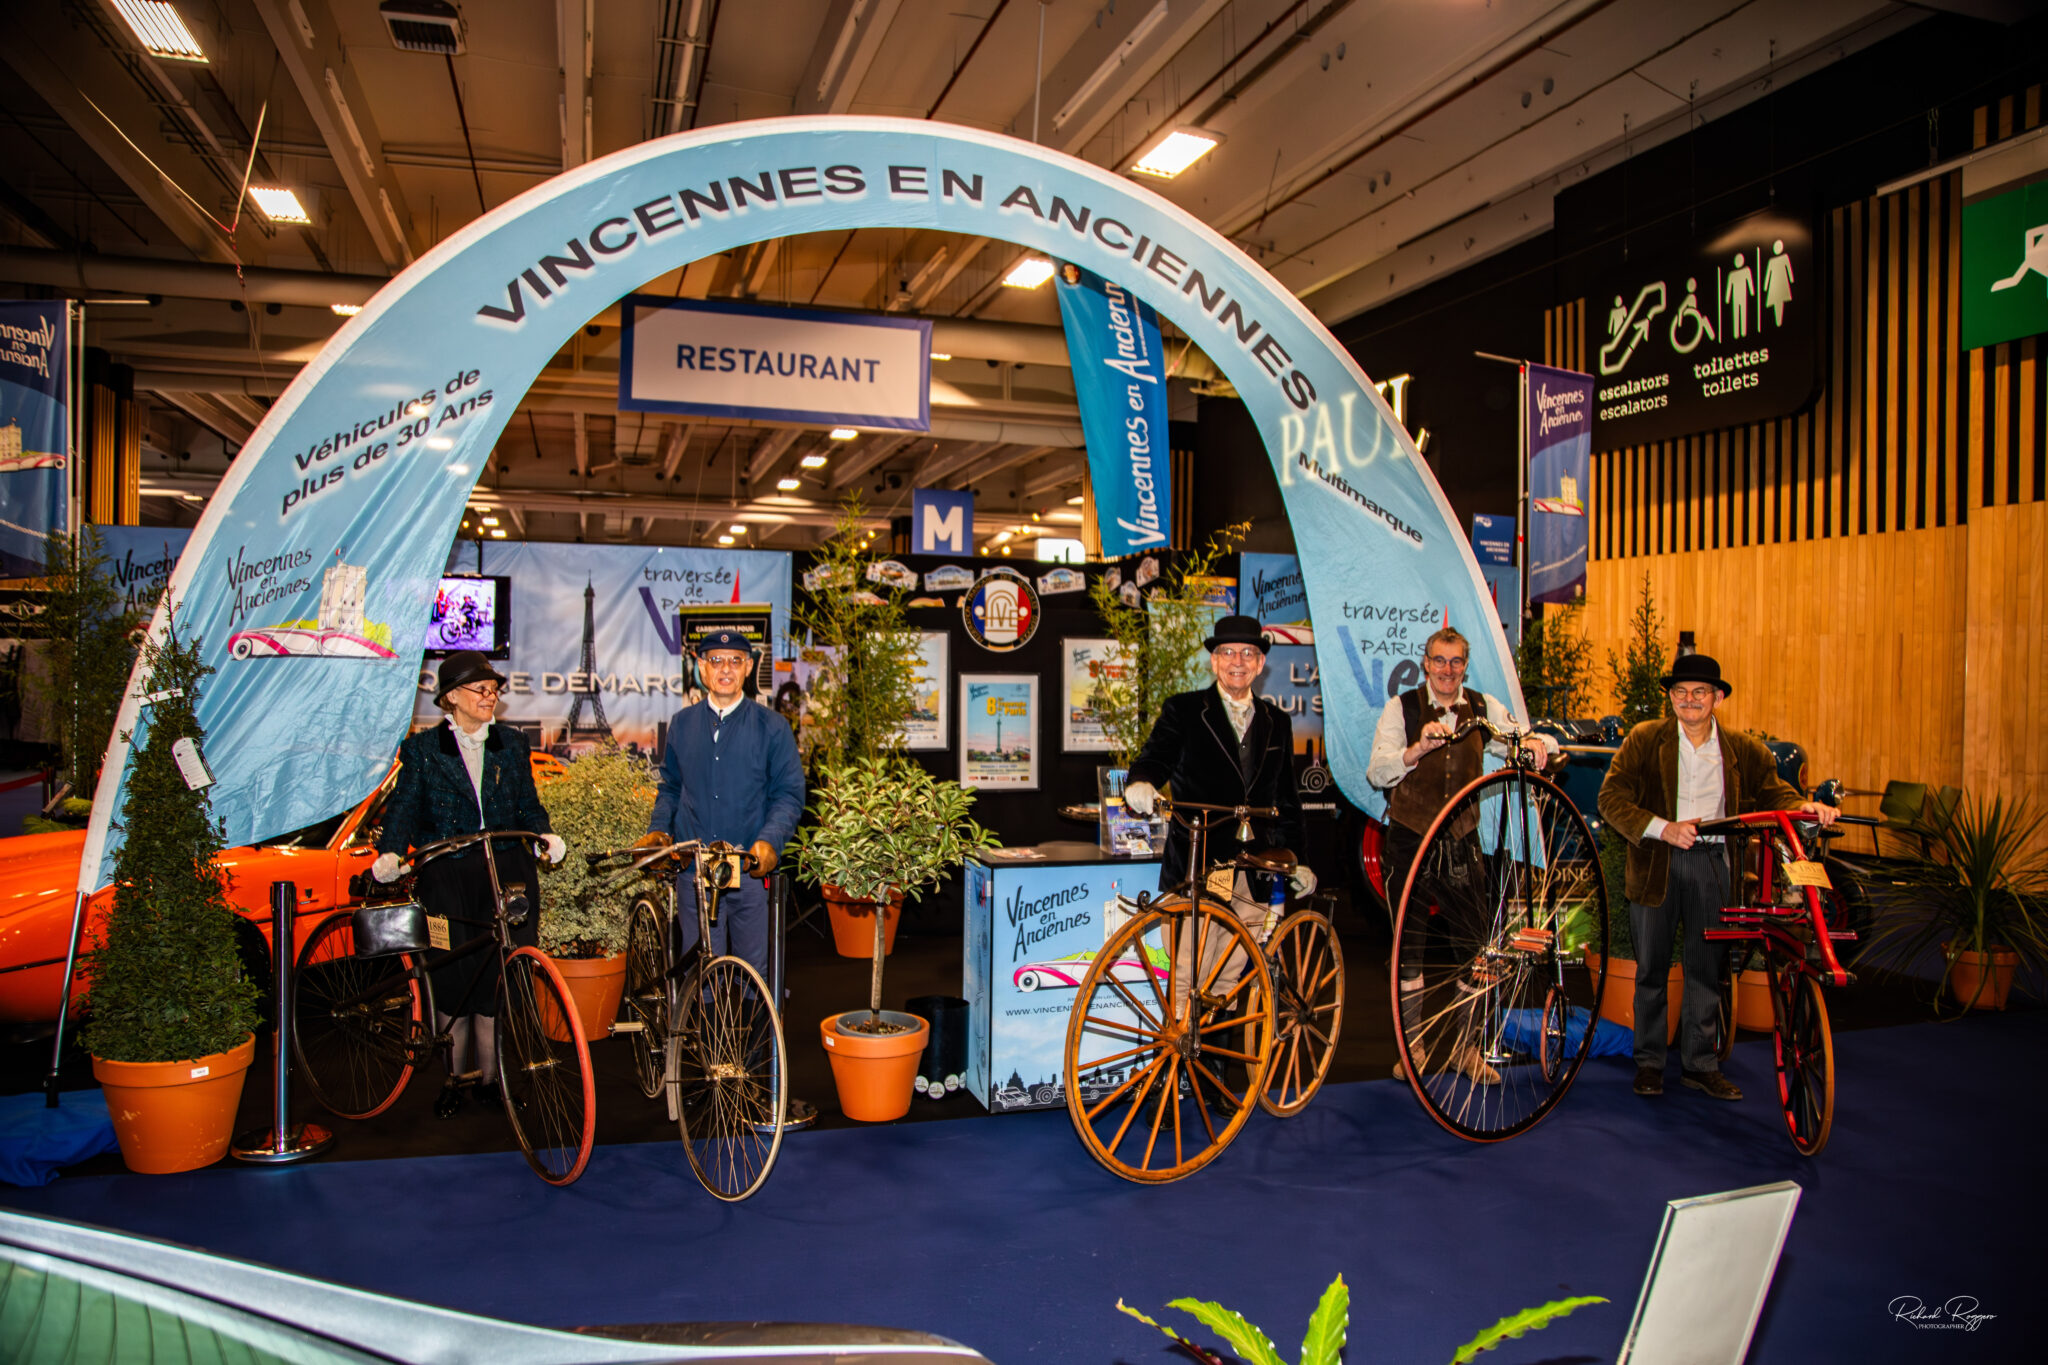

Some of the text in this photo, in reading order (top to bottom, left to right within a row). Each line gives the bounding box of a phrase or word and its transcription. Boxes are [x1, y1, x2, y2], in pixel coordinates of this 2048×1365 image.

[477, 165, 866, 323] VINCENNES
[888, 165, 983, 201] EN
[1001, 186, 1317, 410] ANCIENNES
[677, 344, 880, 383] RESTAURANT
[1693, 347, 1769, 379] toilettes
[1127, 384, 1144, 411] en
[1536, 383, 1585, 413] Vincennes
[1599, 373, 1670, 402] escalators
[1702, 372, 1759, 398] toilets
[295, 369, 480, 471] Véhicules de
[1555, 405, 1565, 416] en
[1600, 394, 1668, 421] escalators
[1540, 410, 1583, 437] Anciennes
[282, 389, 493, 515] plus de 30 Ans
[1117, 416, 1166, 547] Vincennes
[1299, 451, 1423, 543] Multimarque
[923, 504, 963, 552] M
[227, 545, 312, 590] Vincennes
[643, 566, 732, 585] traversée
[260, 576, 277, 589] en
[684, 583, 703, 597] de
[1274, 589, 1285, 600] en
[229, 577, 311, 627] Anciennes
[1342, 601, 1440, 624] traversée
[737, 625, 755, 633] POUR
[1386, 622, 1408, 639] de
[1361, 640, 1427, 657] PARIS
[987, 697, 997, 716] 8
[1006, 883, 1090, 928] Vincennes
[1040, 911, 1056, 925] en
[429, 920, 447, 933] 1886
[1013, 911, 1091, 962] Anciennes
